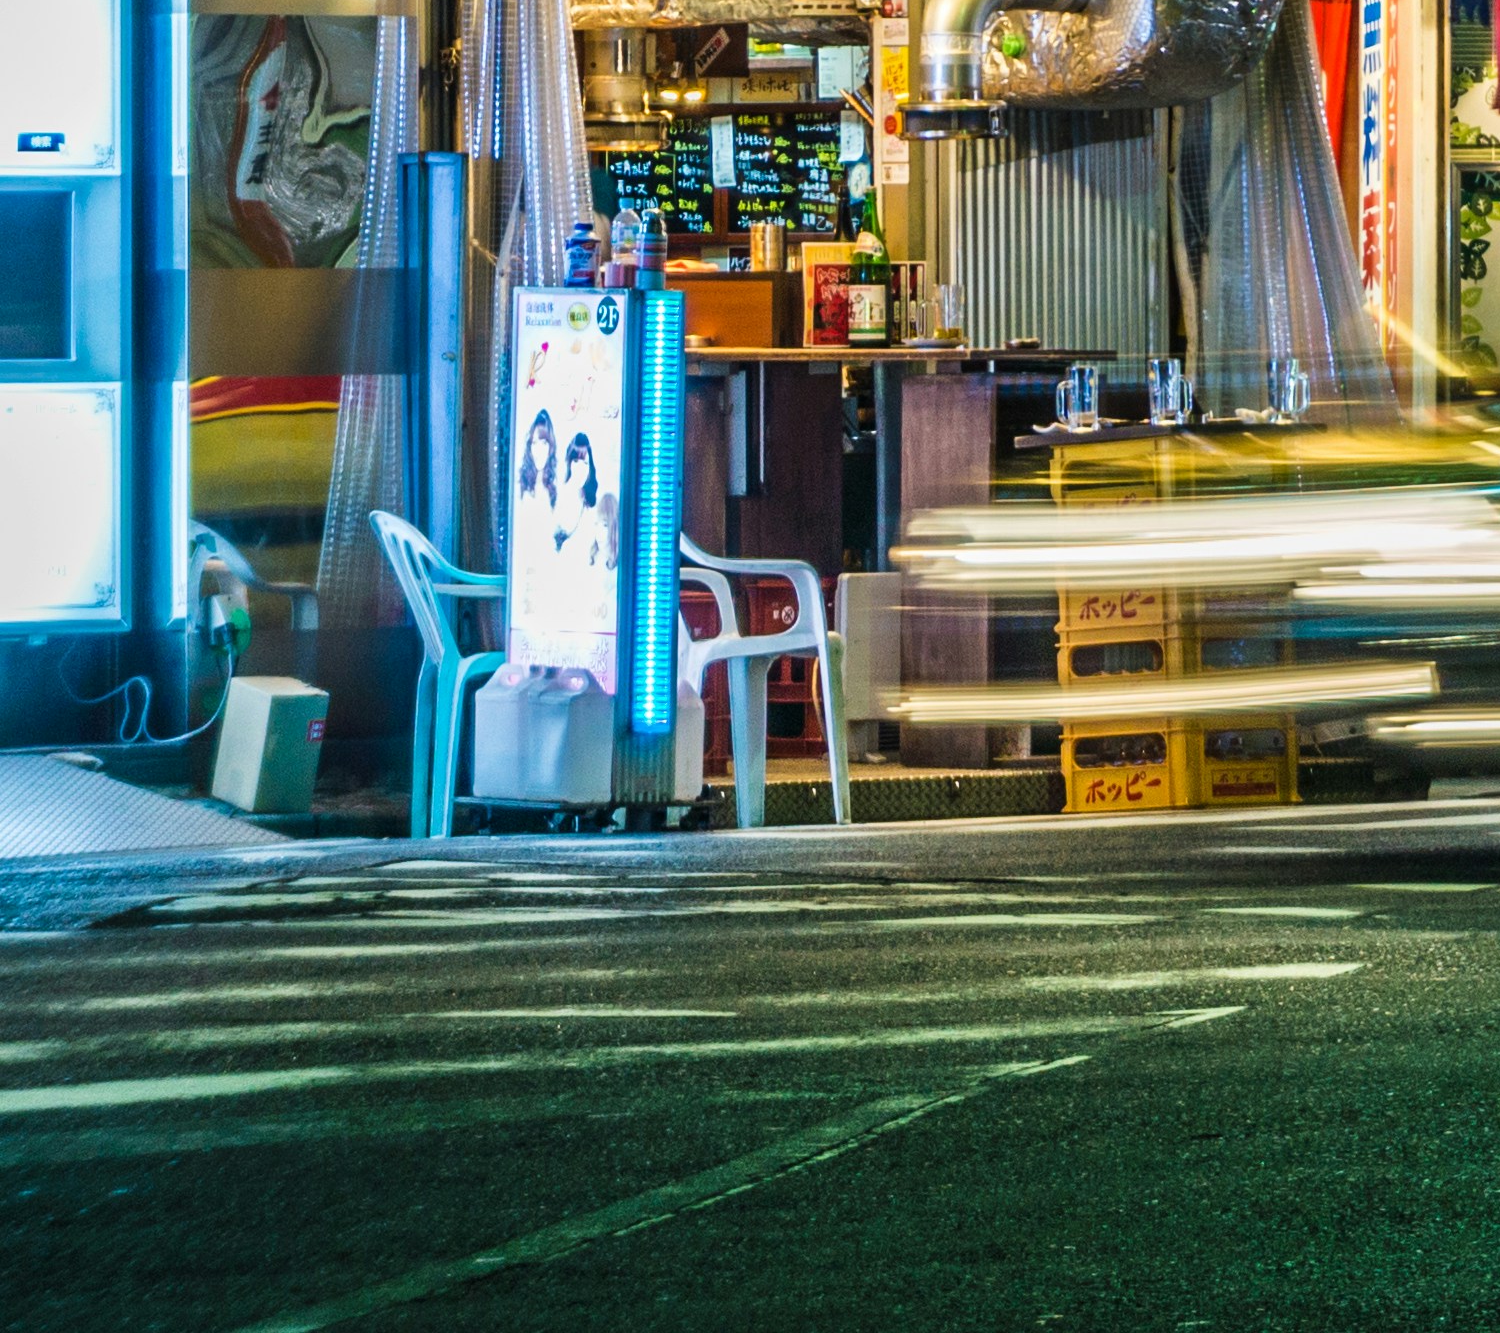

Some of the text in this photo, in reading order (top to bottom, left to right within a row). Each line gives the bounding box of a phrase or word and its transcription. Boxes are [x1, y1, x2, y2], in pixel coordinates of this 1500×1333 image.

[525, 315, 562, 327] Relaxation
[598, 304, 619, 330] 2F
[1079, 588, 1156, 621] ホッピー
[1085, 772, 1162, 805] ホッピー
